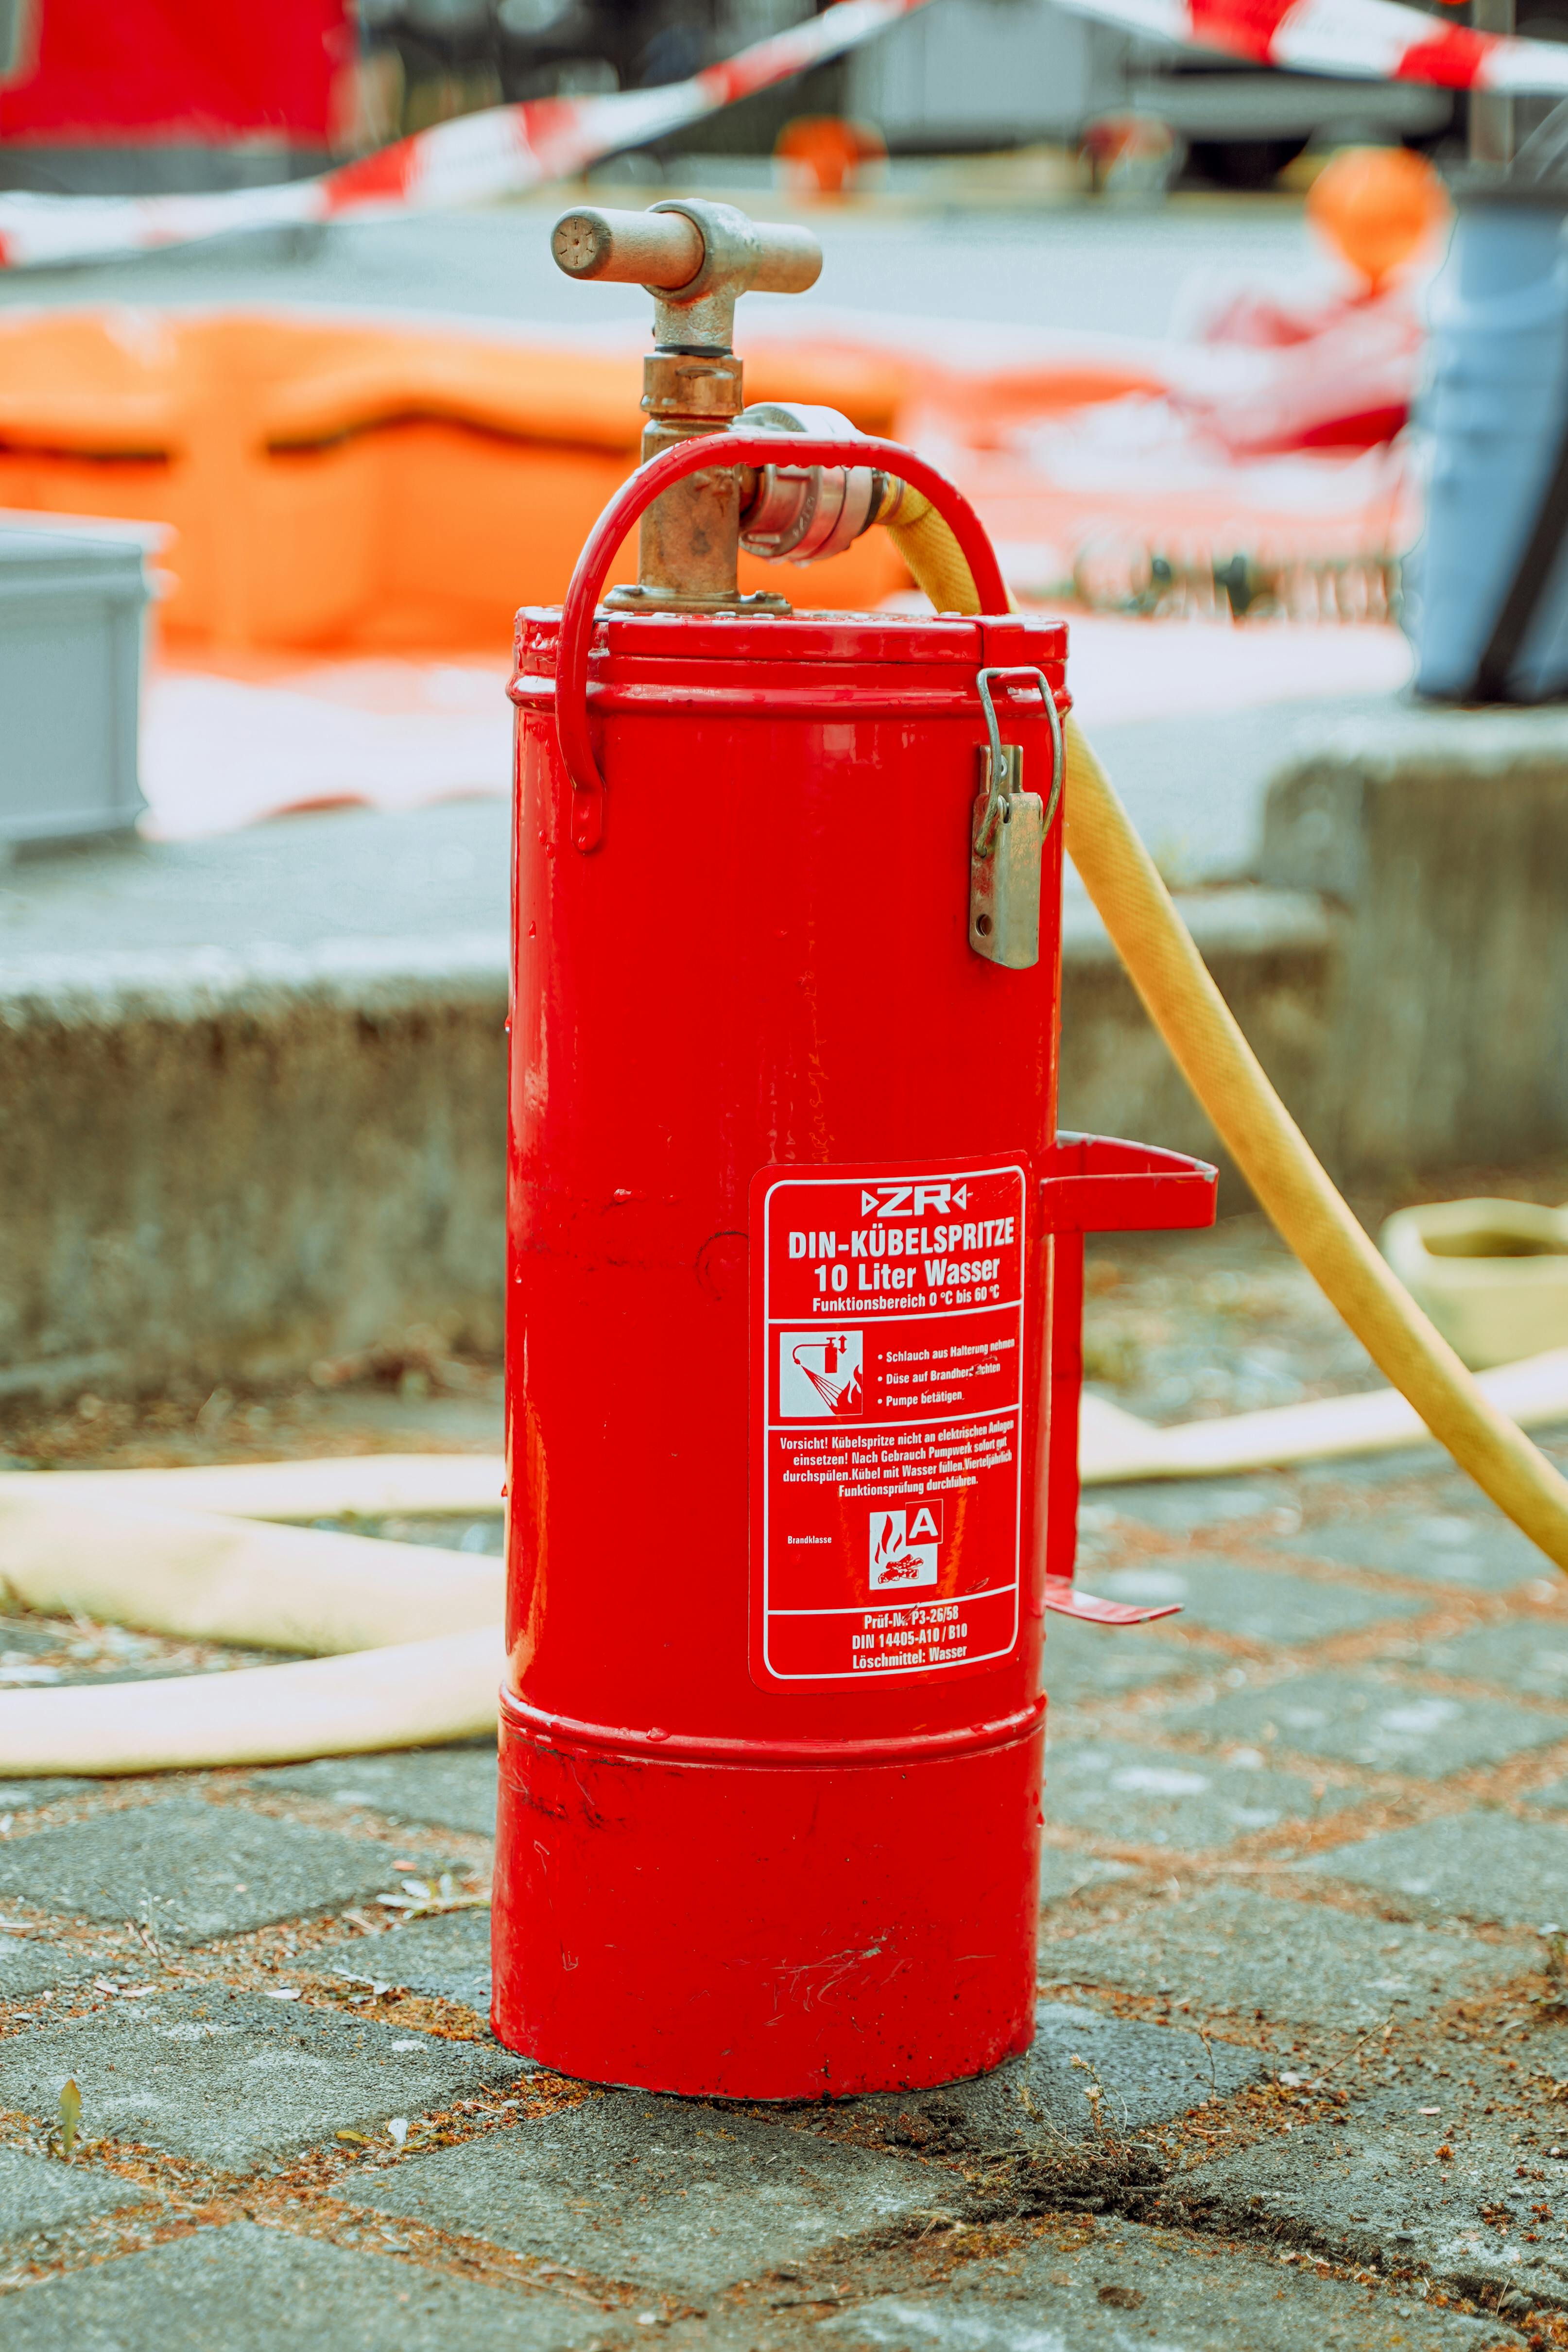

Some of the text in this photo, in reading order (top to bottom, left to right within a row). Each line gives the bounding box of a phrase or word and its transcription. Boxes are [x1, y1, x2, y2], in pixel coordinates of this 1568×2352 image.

[877, 1184, 951, 1217] ZR
[789, 1216, 1015, 1259] DIN-KÜBELSPRITZE
[814, 1258, 1000, 1292] 10 Liter Wasser
[813, 1293, 926, 1312] Funktionsbereich
[929, 1292, 937, 1306] 0
[956, 1288, 972, 1304] bis
[974, 1286, 987, 1302] 60
[886, 1339, 1015, 1363] Schlauch aus Halterung nehmen
[886, 1373, 910, 1385] Düse
[912, 1371, 928, 1383] auf
[886, 1391, 962, 1408] Pumpe betätigen
[780, 1420, 1014, 1450] Vorsicht! Kübelspritze nicht an elektrischen Anlagen
[793, 1452, 848, 1466] einsetzen!
[852, 1451, 878, 1464] Nach
[881, 1447, 926, 1462] Gebrauch
[929, 1442, 972, 1459] Pumpwerk
[974, 1439, 996, 1453] sofort
[883, 1466, 899, 1478] mit
[902, 1464, 937, 1477] Wasser
[839, 1475, 979, 1497] Funktionsprüfung durchführen.
[909, 1508, 938, 1539] A
[788, 1535, 832, 1544] Brandklasse
[912, 1605, 959, 1625] P3-26/58
[852, 1634, 875, 1649] DIN
[853, 1646, 967, 1669] Löschmittel: Wasser
